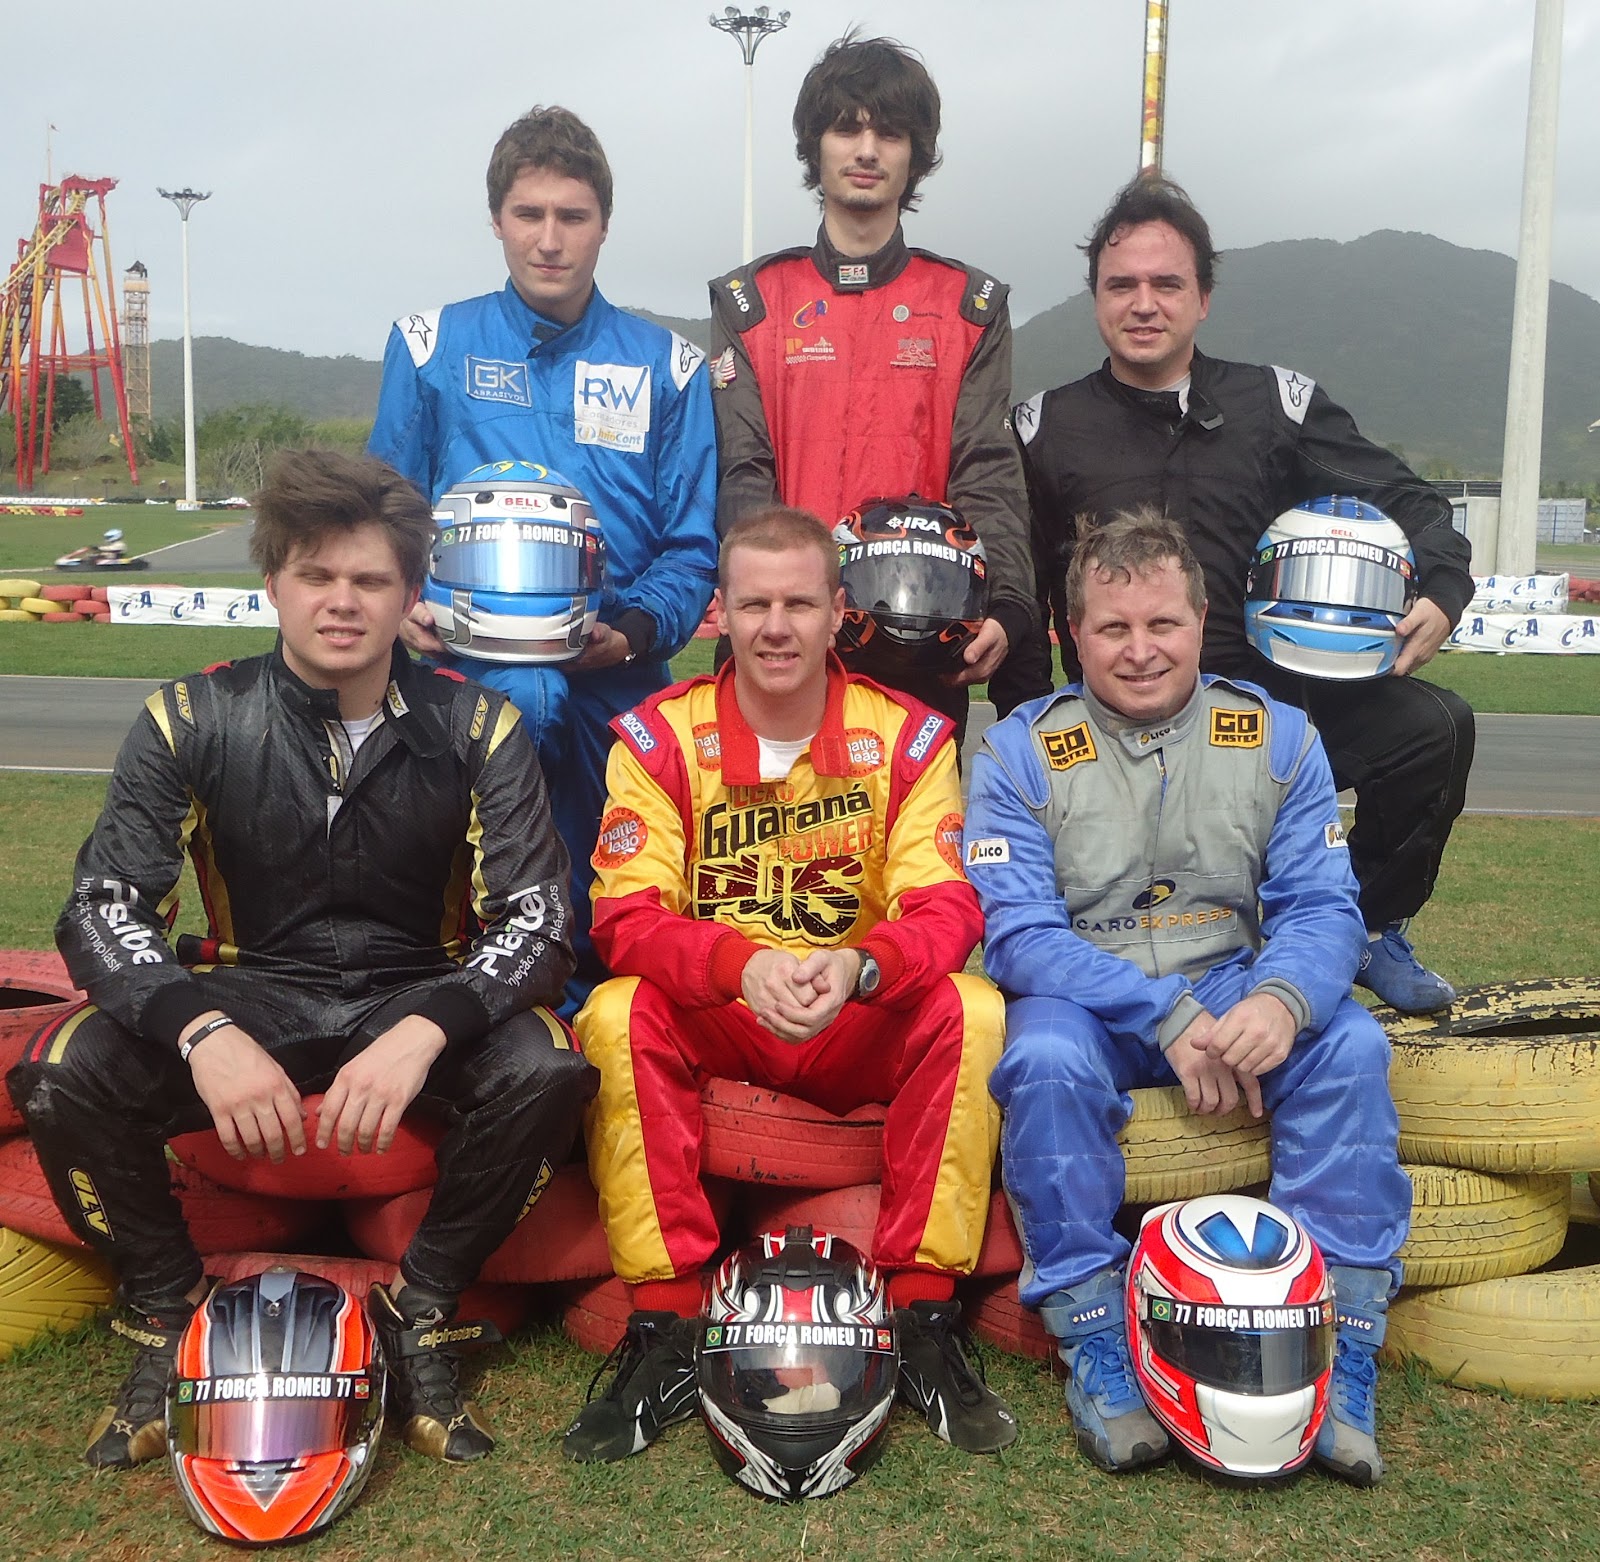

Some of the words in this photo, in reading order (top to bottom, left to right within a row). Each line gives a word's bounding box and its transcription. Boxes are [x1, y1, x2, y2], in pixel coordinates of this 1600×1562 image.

[732, 289, 750, 312] LICO
[980, 280, 994, 300] LICO
[475, 365, 522, 392] GK
[473, 389, 525, 402] ABRASIVOS
[579, 367, 648, 413] RW
[505, 497, 542, 509] BELL
[458, 526, 472, 543] 77
[476, 524, 520, 541] FORA
[522, 525, 569, 545] ROMEU
[571, 531, 583, 548] 77
[902, 516, 942, 535] IRA
[1331, 529, 1354, 538] BELL
[850, 545, 863, 562] 77
[867, 540, 910, 557] FORÇA
[913, 541, 957, 562] ROMEU
[959, 551, 972, 569] 77
[1275, 542, 1290, 559] 77
[1291, 539, 1336, 556] FORÇA
[1337, 540, 1384, 563] ROMEU
[1386, 552, 1398, 570] 77
[620, 713, 655, 753] sparco
[1215, 712, 1258, 733] GO
[908, 716, 943, 761] sparco
[1045, 727, 1087, 757] GO
[1150, 728, 1171, 741] LICO
[1214, 734, 1258, 742] FASTER
[850, 749, 880, 763] leão
[1052, 748, 1090, 767] FASTER
[600, 820, 638, 845] matte
[703, 783, 872, 860] Guaraná
[779, 815, 873, 861] POWER
[979, 847, 1002, 857] LICO
[532, 942, 545, 957] de
[1080, 1306, 1106, 1322] LICO
[1175, 1304, 1191, 1325] 77
[1196, 1306, 1250, 1331] FORÇA
[1252, 1309, 1305, 1330] ROMEU
[1307, 1306, 1320, 1326] 77
[1347, 1317, 1372, 1331] LICO
[418, 1326, 482, 1348] alpinestars
[725, 1326, 741, 1345] 77
[745, 1324, 798, 1347] FORÇA
[800, 1326, 855, 1347] ROMEU
[859, 1328, 874, 1347] 77
[196, 1381, 211, 1400] 77
[214, 1378, 270, 1401] FORÇA
[272, 1377, 332, 1398] ROMEU
[336, 1377, 351, 1398] 77
